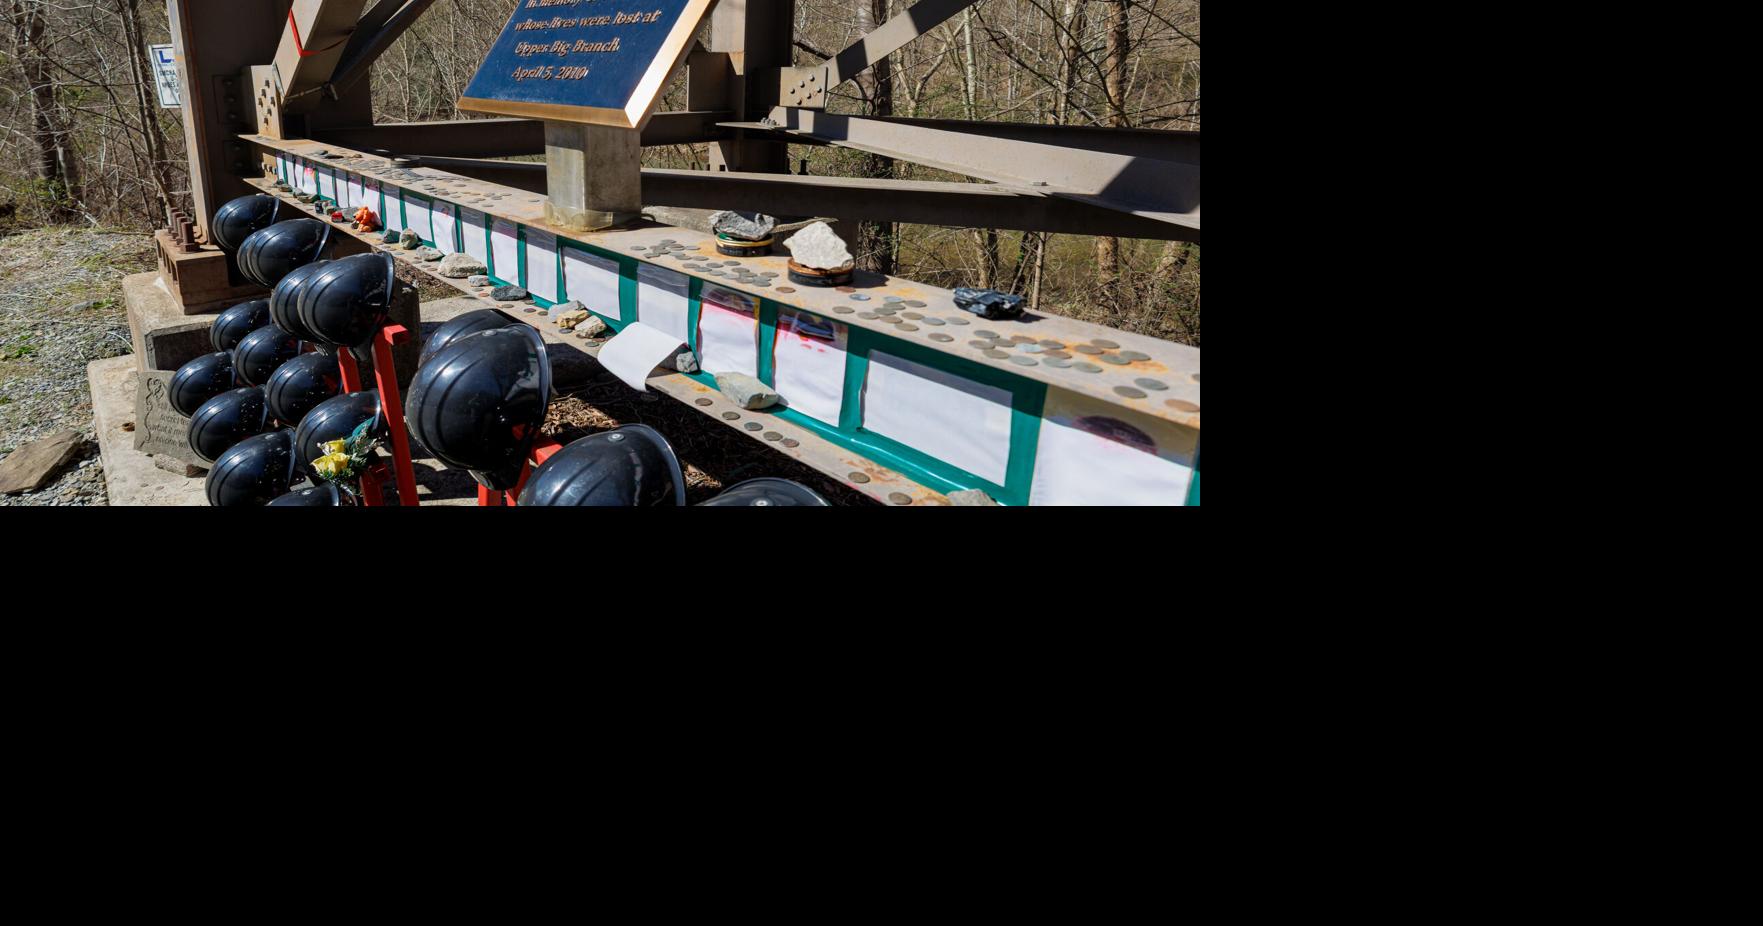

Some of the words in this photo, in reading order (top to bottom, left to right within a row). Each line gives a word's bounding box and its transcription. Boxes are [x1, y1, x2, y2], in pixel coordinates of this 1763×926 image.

[515, 19, 547, 31] whose
[549, 16, 578, 29] lives
[579, 15, 611, 26] were
[612, 10, 641, 25] lost
[641, 9, 662, 23] at
[515, 41, 549, 56] Upper
[549, 40, 571, 56] Big
[512, 66, 544, 81] April
[555, 65, 589, 81] 2010
